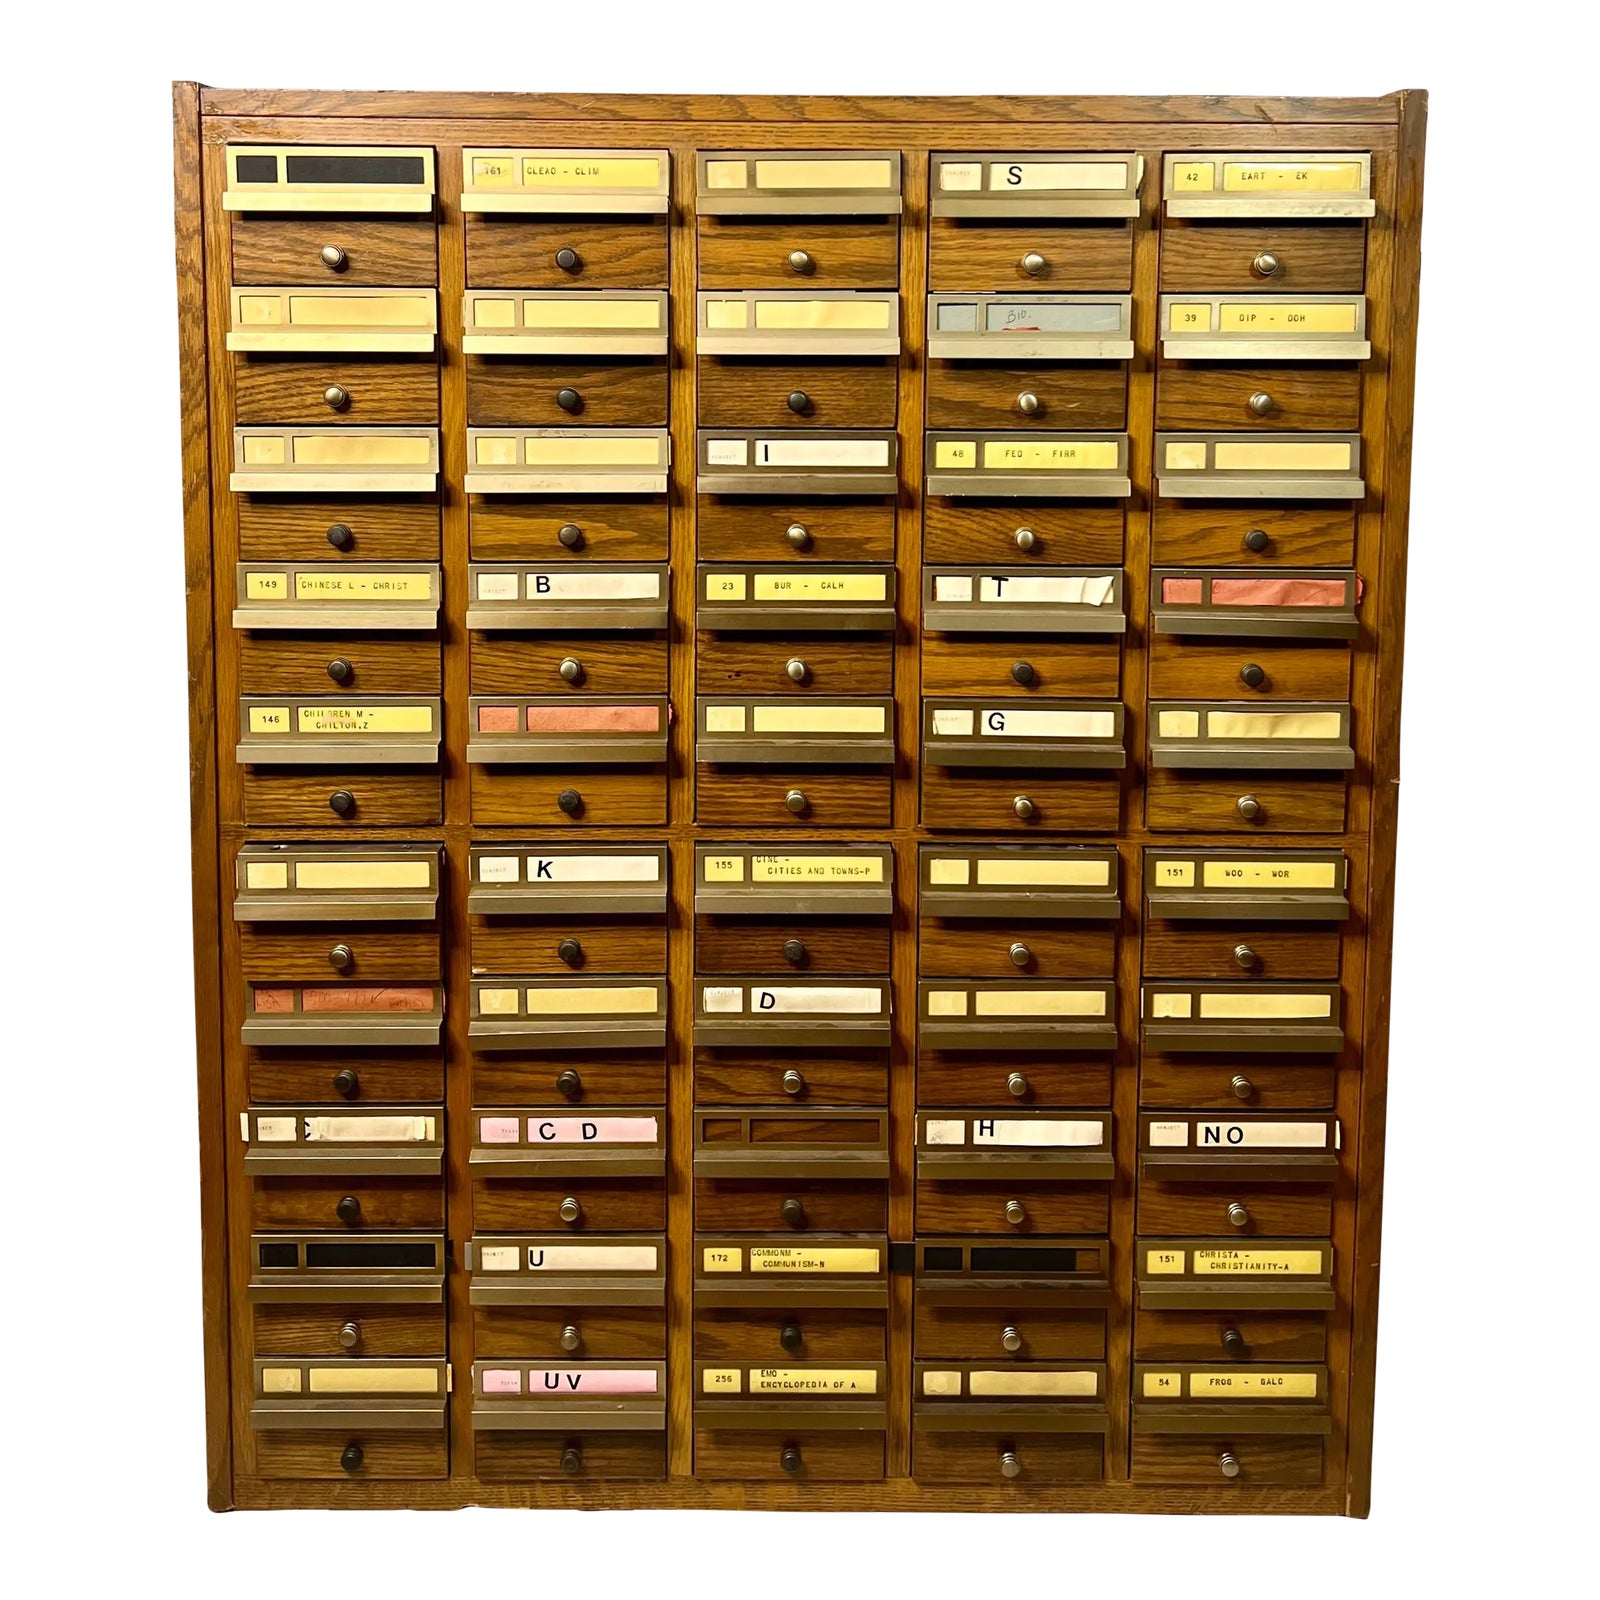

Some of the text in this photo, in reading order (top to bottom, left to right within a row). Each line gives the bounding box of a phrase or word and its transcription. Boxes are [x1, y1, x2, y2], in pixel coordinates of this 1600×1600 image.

[575, 167, 600, 175] CLIM
[1007, 166, 1022, 185] S
[1186, 173, 1199, 181] 42
[1241, 172, 1265, 180] EART
[1296, 172, 1308, 180] EK
[1185, 314, 1197, 322] 39
[764, 444, 769, 462] I
[259, 580, 277, 588] 149
[301, 580, 342, 589] CHINESE
[349, 581, 354, 589] L
[373, 581, 408, 589] CHRIST
[536, 575, 551, 593] B
[722, 582, 734, 590] 23
[774, 581, 792, 589] BUR
[821, 581, 844, 589] CALH
[991, 576, 1009, 597] T
[356, 710, 363, 718] M
[262, 715, 280, 724] 146
[988, 712, 1005, 731] G
[715, 861, 733, 869] 155
[537, 860, 553, 879] K
[767, 867, 871, 875] CITIES AND TOWNS-P
[1272, 870, 1290, 878] WOR
[759, 991, 776, 1009] D
[539, 1122, 598, 1140] C D
[979, 1120, 994, 1137] H
[529, 1249, 544, 1267] U
[711, 1254, 728, 1262] 172
[1199, 1250, 1239, 1259] CHRISTA
[1159, 1255, 1175, 1263] 151
[762, 1260, 825, 1268] COMMUNISM-N
[1210, 1262, 1289, 1271] CHRISTIANITY-A
[761, 1369, 777, 1377] EMO
[715, 1375, 732, 1383] 256
[1158, 1378, 1170, 1386] 54
[1209, 1378, 1232, 1386] FROG
[1260, 1378, 1284, 1386] GALC
